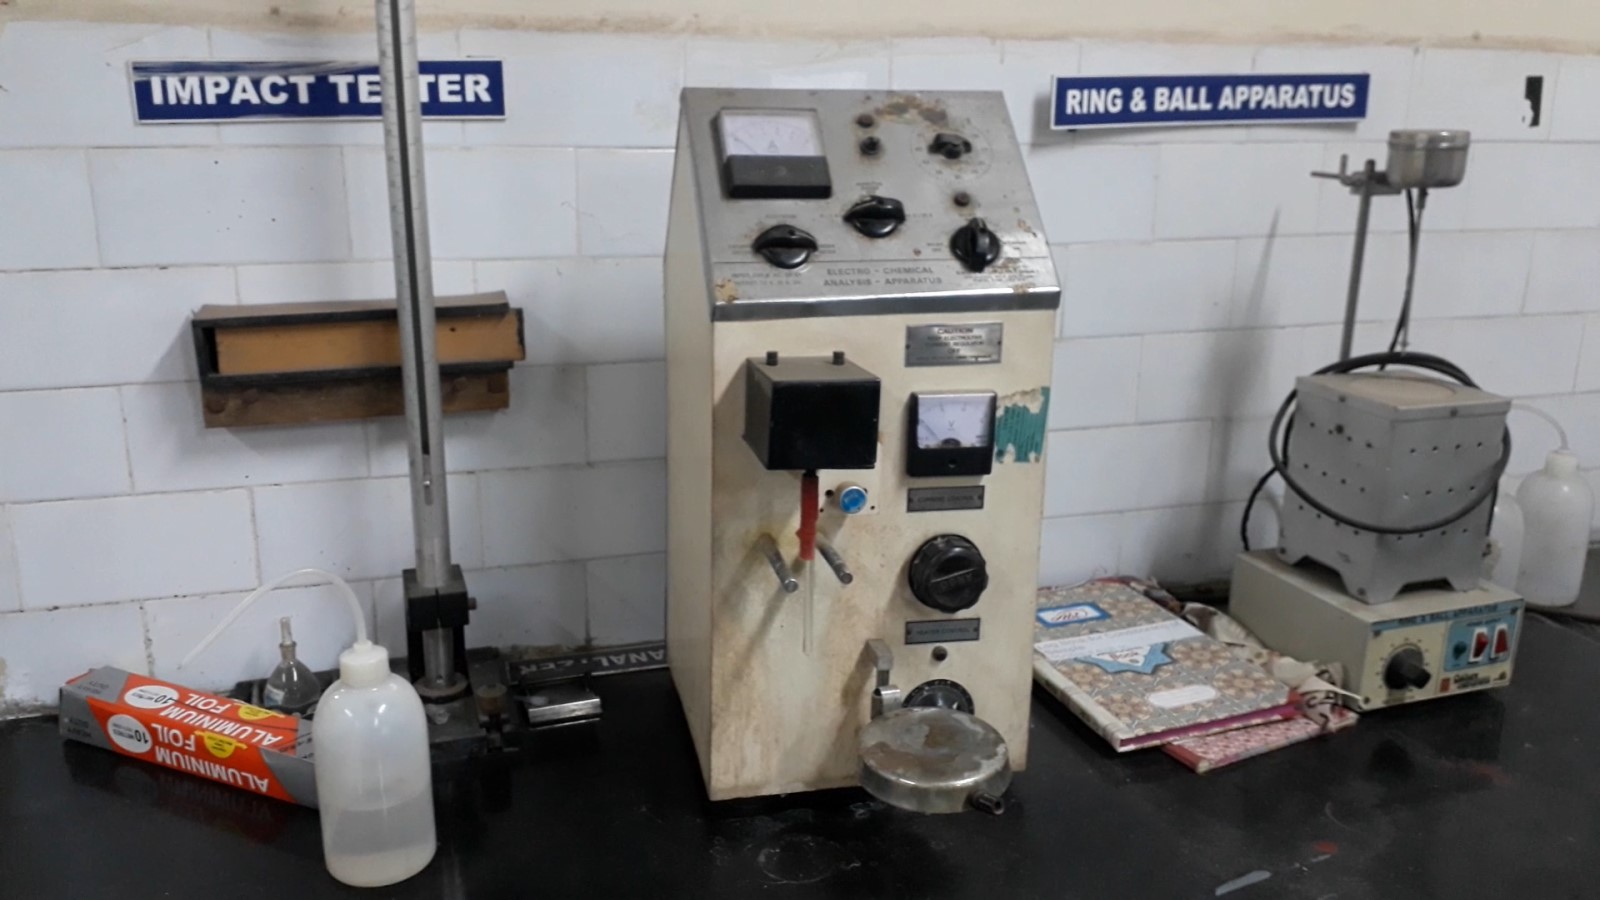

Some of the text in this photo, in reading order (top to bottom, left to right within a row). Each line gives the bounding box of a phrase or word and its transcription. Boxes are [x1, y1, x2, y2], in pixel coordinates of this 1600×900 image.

[151, 74, 492, 105] IMPACT TETER
[1065, 83, 1356, 115] RING & BALL APPARATUS
[823, 277, 873, 287] ANALYSIS
[884, 277, 943, 287] APPARATUS
[826, 266, 871, 276] ELECTRO
[883, 266, 934, 275] CHEMICAL
[936, 327, 974, 335] CAUTION
[184, 693, 230, 714] FOIL
[134, 728, 149, 745] 10
[150, 723, 196, 752] FOIL
[160, 705, 283, 746] ALUMINIUM
[155, 745, 269, 793] ALUMINIUM
